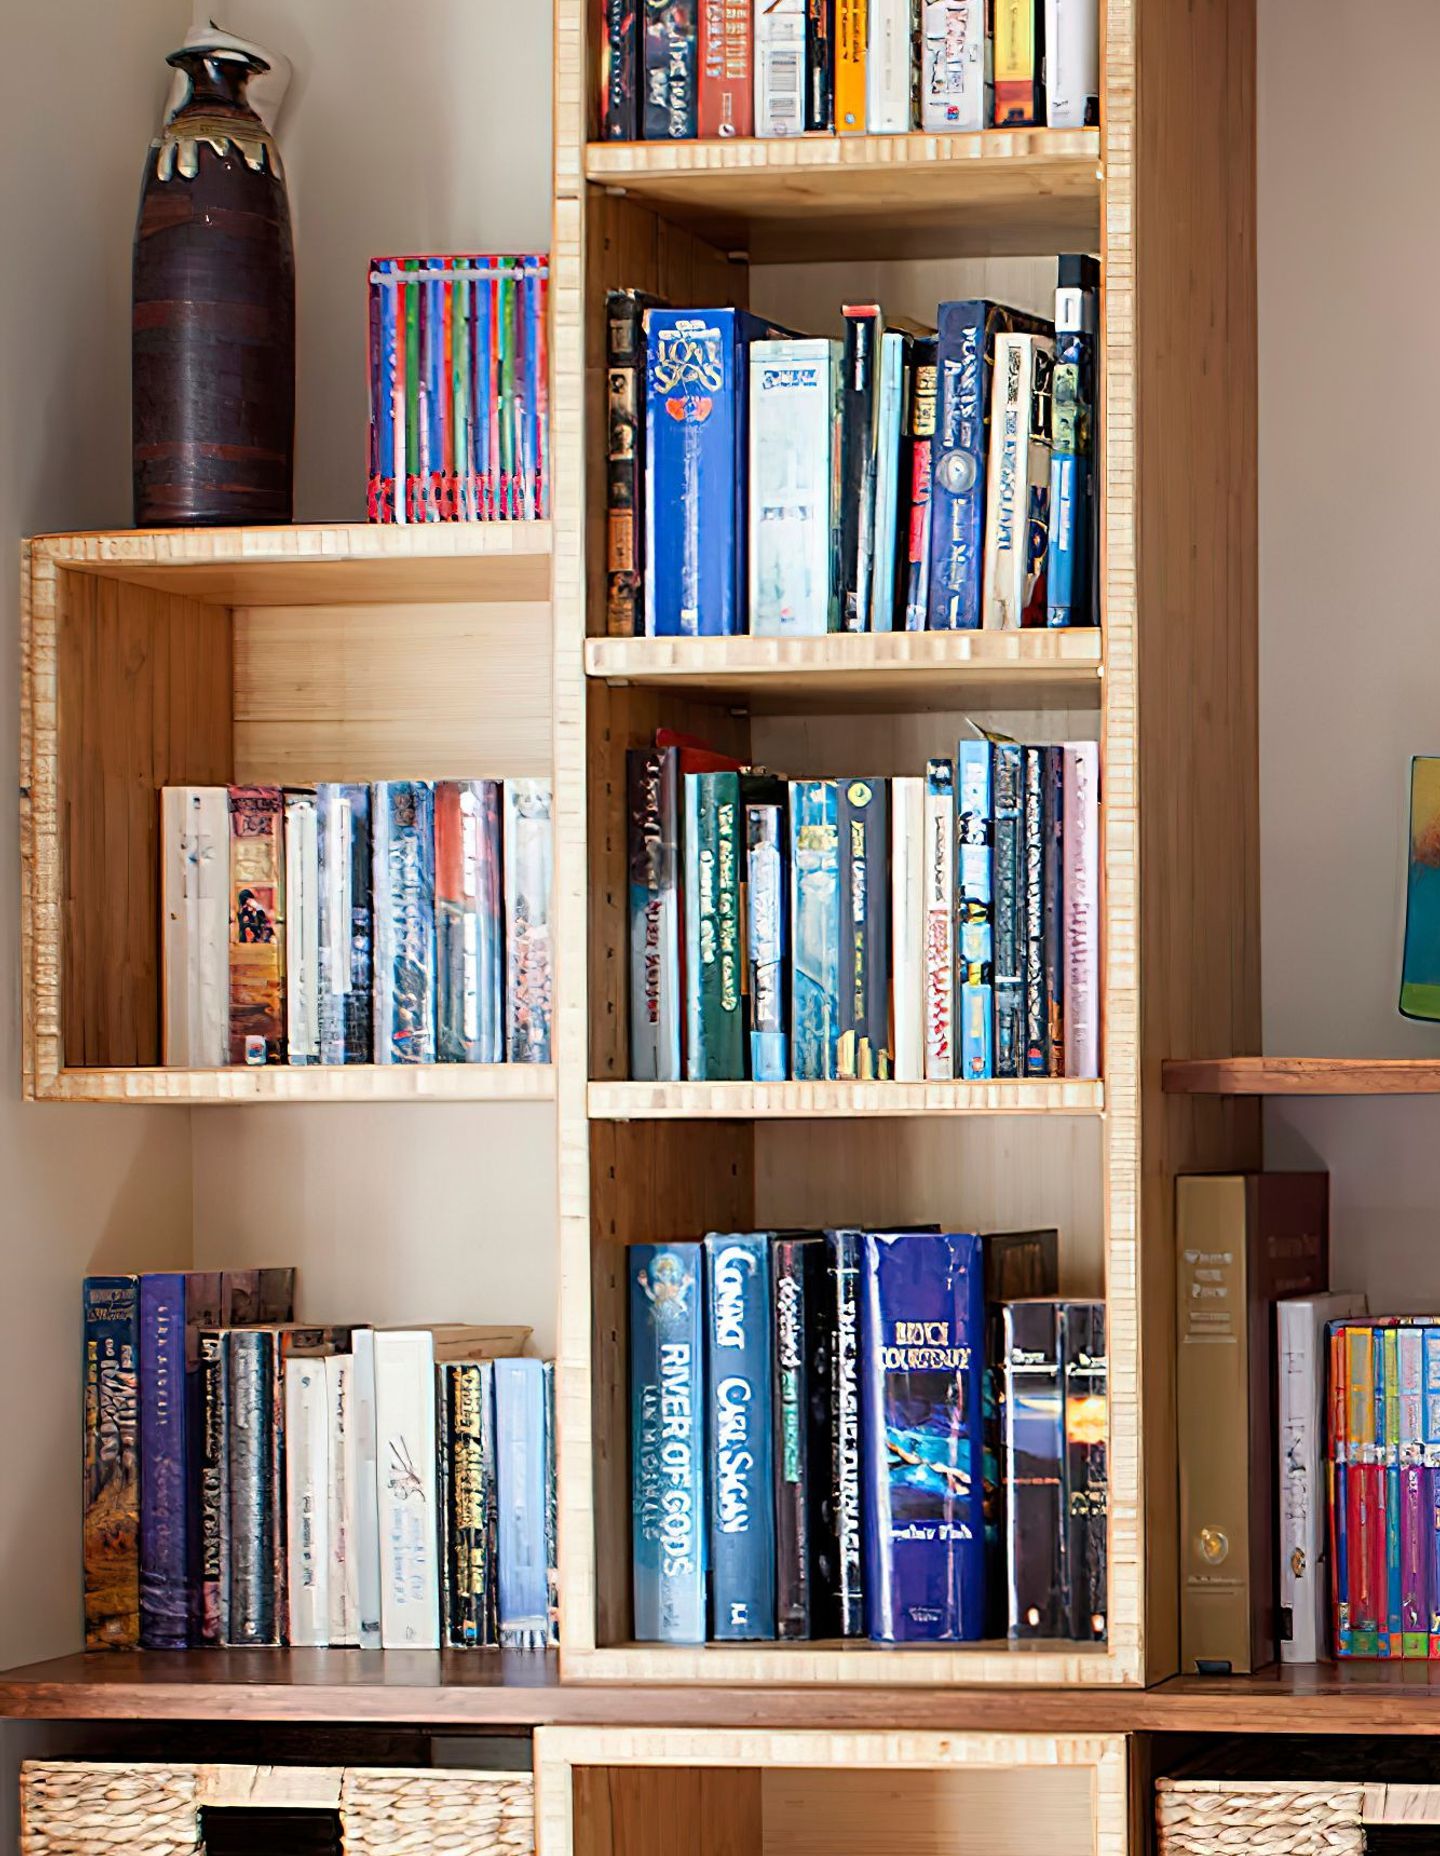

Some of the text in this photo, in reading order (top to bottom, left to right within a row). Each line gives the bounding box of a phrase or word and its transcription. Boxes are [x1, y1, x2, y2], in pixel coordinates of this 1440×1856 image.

[716, 1377, 752, 1450] CARL
[660, 1343, 691, 1578] RIVER OF GODS
[717, 1450, 755, 1534] SAGAN
